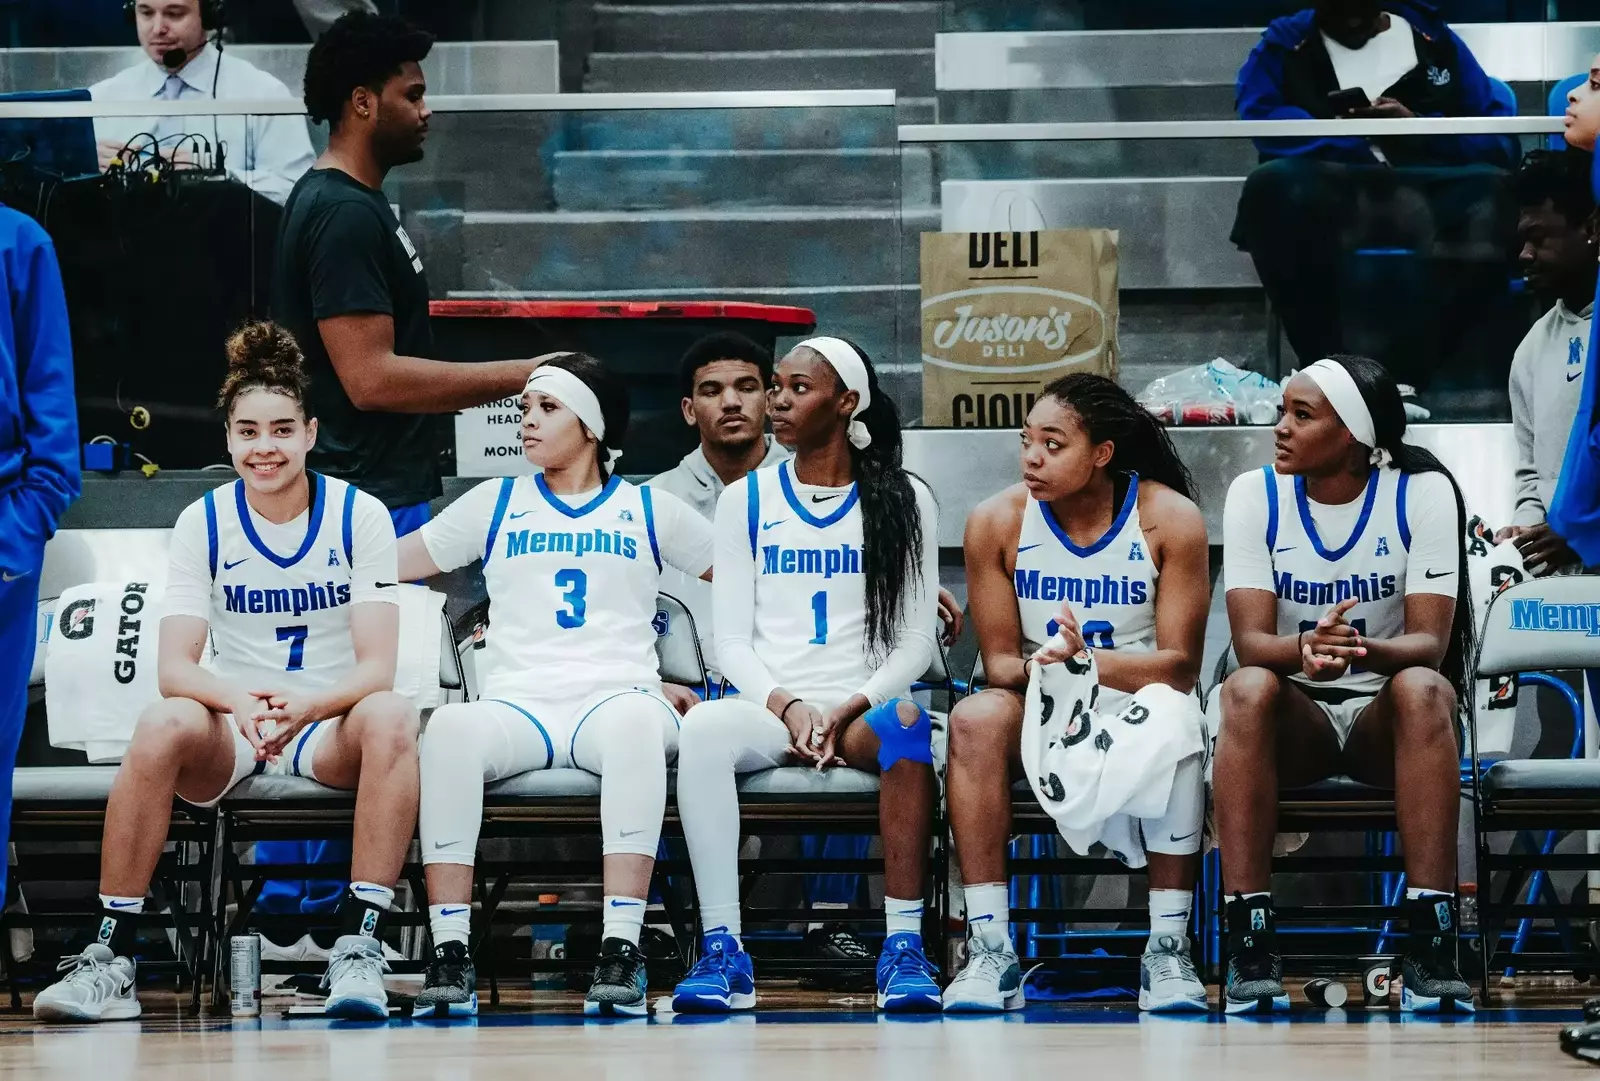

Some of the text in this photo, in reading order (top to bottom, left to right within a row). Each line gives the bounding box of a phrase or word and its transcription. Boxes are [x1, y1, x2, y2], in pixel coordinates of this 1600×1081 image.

[969, 231, 1039, 268] DELI
[933, 305, 1071, 350] Jason's
[983, 344, 1025, 357] DELI
[487, 414, 523, 425] HEAD
[484, 446, 522, 457] MONI
[506, 528, 638, 560] Memphis
[222, 580, 351, 617] Memphis
[554, 568, 588, 630] 3
[1014, 569, 1148, 608] Memphis
[1272, 570, 1397, 606] Memphis
[60, 598, 97, 641] G
[808, 590, 829, 645] 1
[275, 625, 309, 672] 7
[1366, 966, 1390, 997] G
